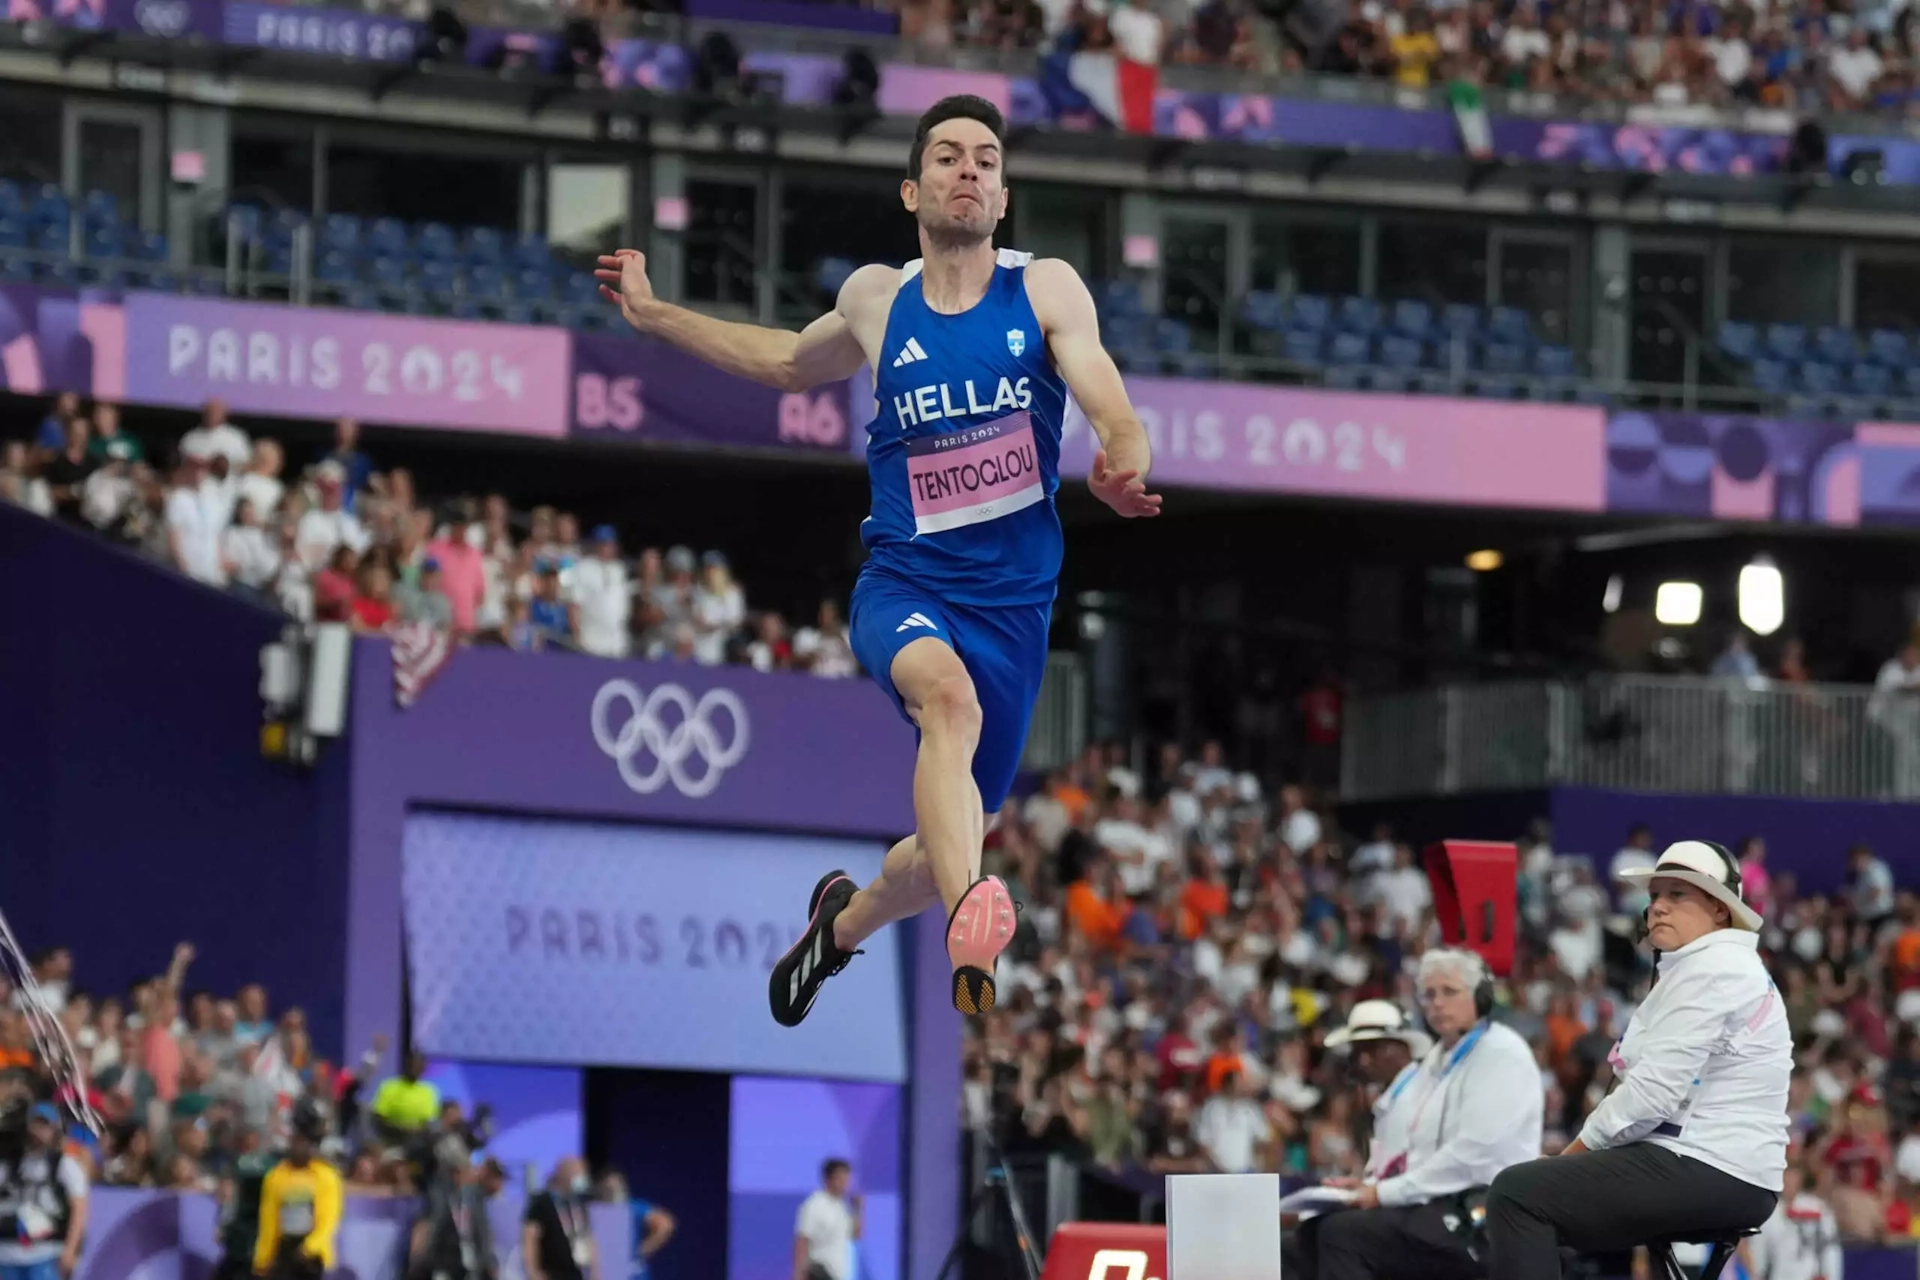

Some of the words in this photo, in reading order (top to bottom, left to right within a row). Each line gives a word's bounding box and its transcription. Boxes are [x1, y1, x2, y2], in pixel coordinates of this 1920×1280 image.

[256, 12, 358, 57] PARIS
[168, 324, 341, 389] PARIS
[361, 342, 522, 401] 2024
[893, 376, 1033, 430] HELLAS
[934, 433, 969, 449] PARIS
[971, 425, 1001, 442] 2024
[1245, 414, 1406, 473] 2024
[912, 444, 1034, 501] TENTOGLOU
[505, 905, 661, 964] PARIS
